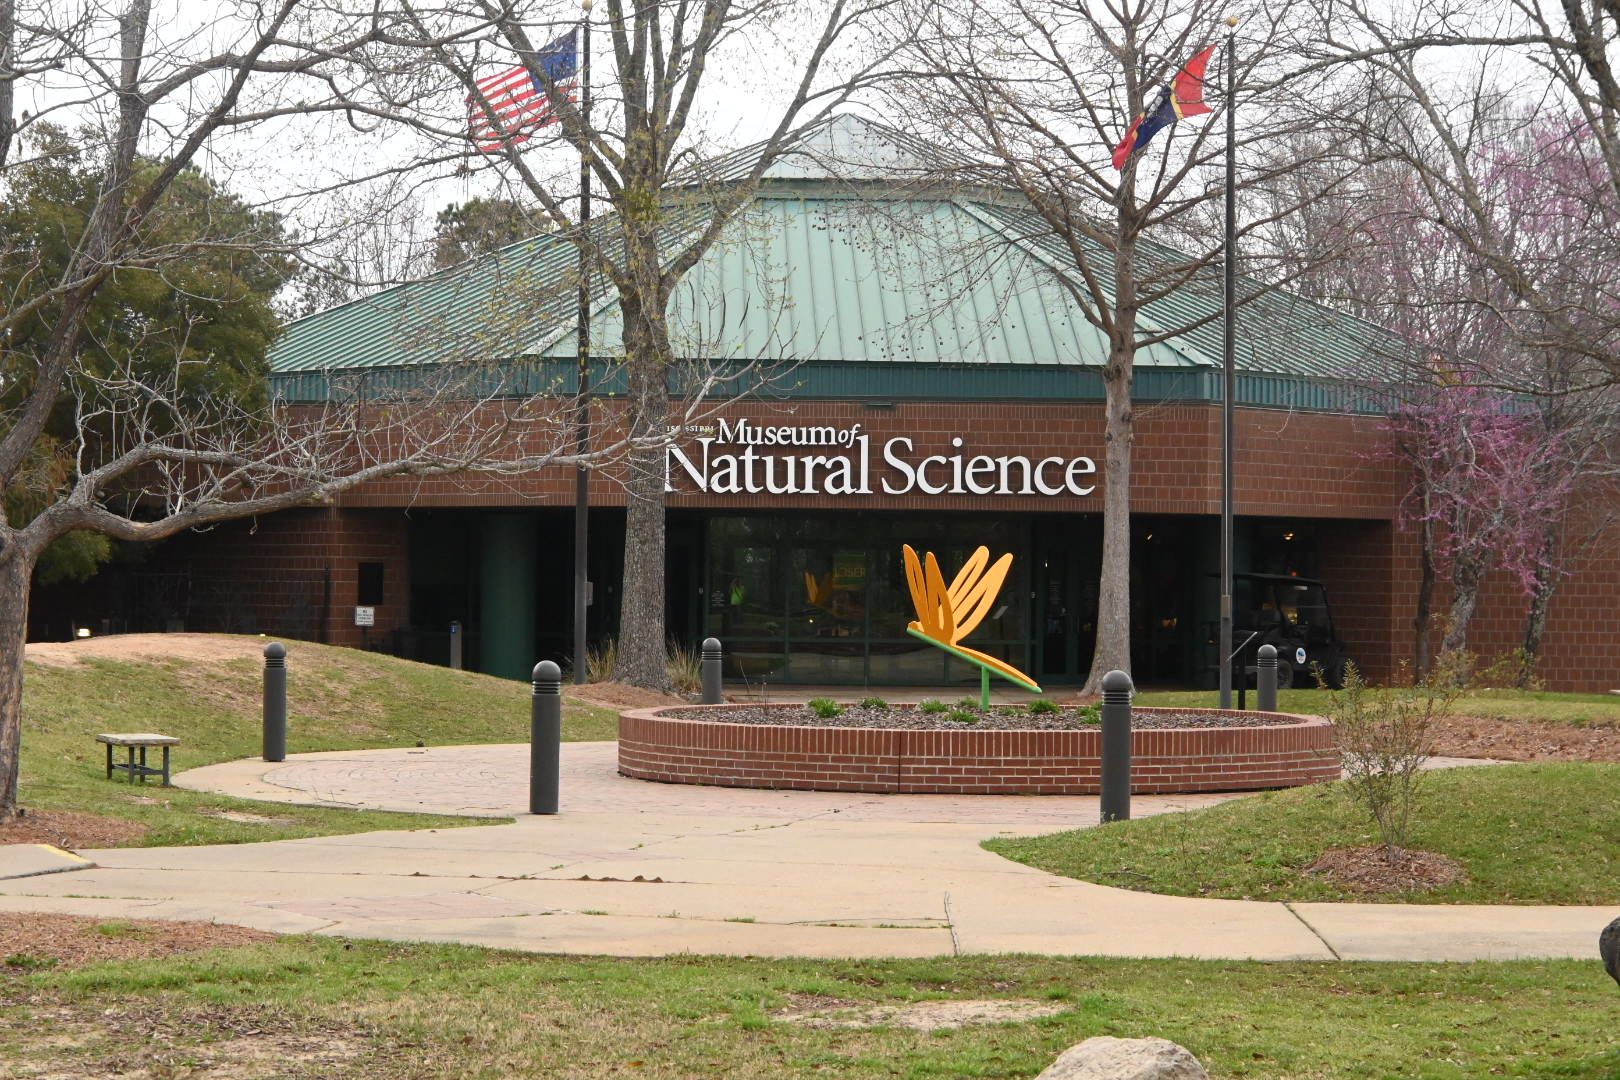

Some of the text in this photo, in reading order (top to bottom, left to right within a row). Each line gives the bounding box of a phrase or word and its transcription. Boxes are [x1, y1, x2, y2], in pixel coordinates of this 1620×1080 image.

[716, 417, 861, 449] Museum of
[664, 434, 1096, 495] Natural Science
